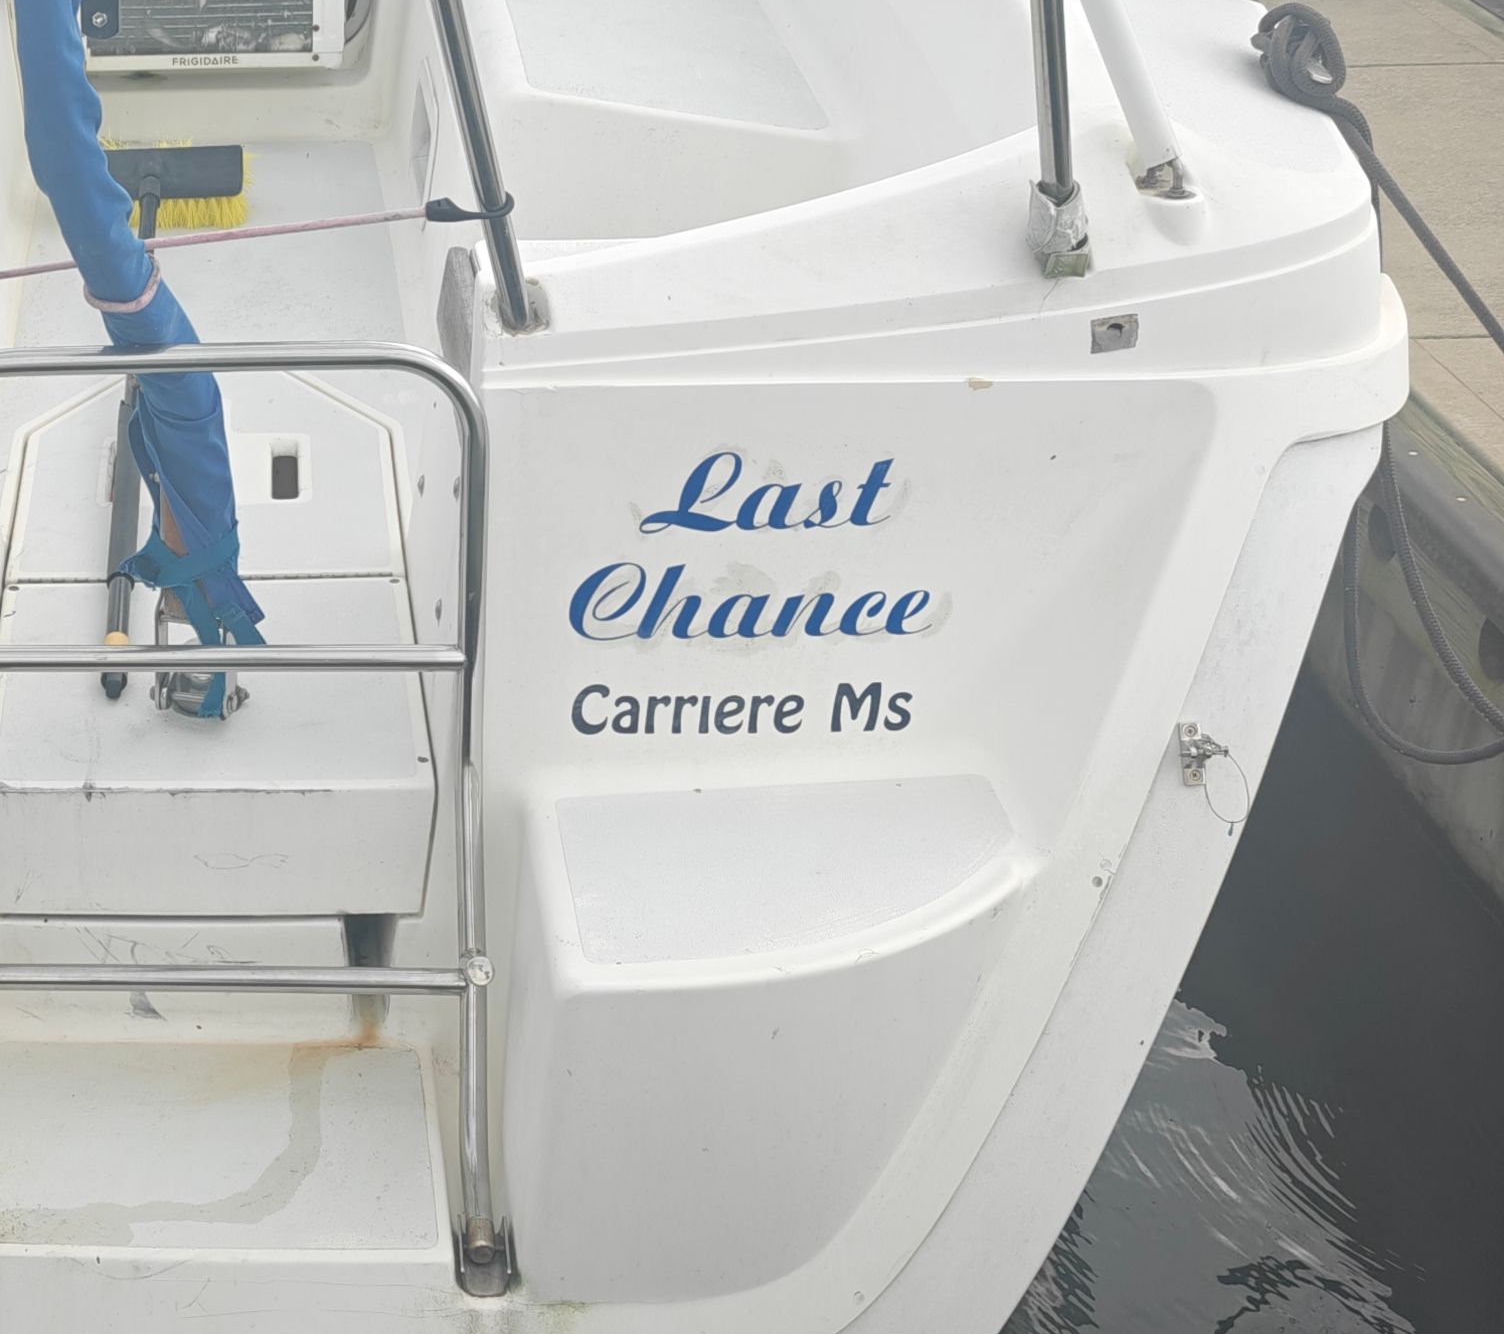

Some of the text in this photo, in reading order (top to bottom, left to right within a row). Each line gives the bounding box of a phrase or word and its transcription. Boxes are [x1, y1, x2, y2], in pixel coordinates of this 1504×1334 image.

[172, 56, 239, 67] FRIGIDAIRE
[639, 451, 895, 534] Last
[569, 562, 933, 641] Chance
[571, 681, 913, 735] Carriere Ms
